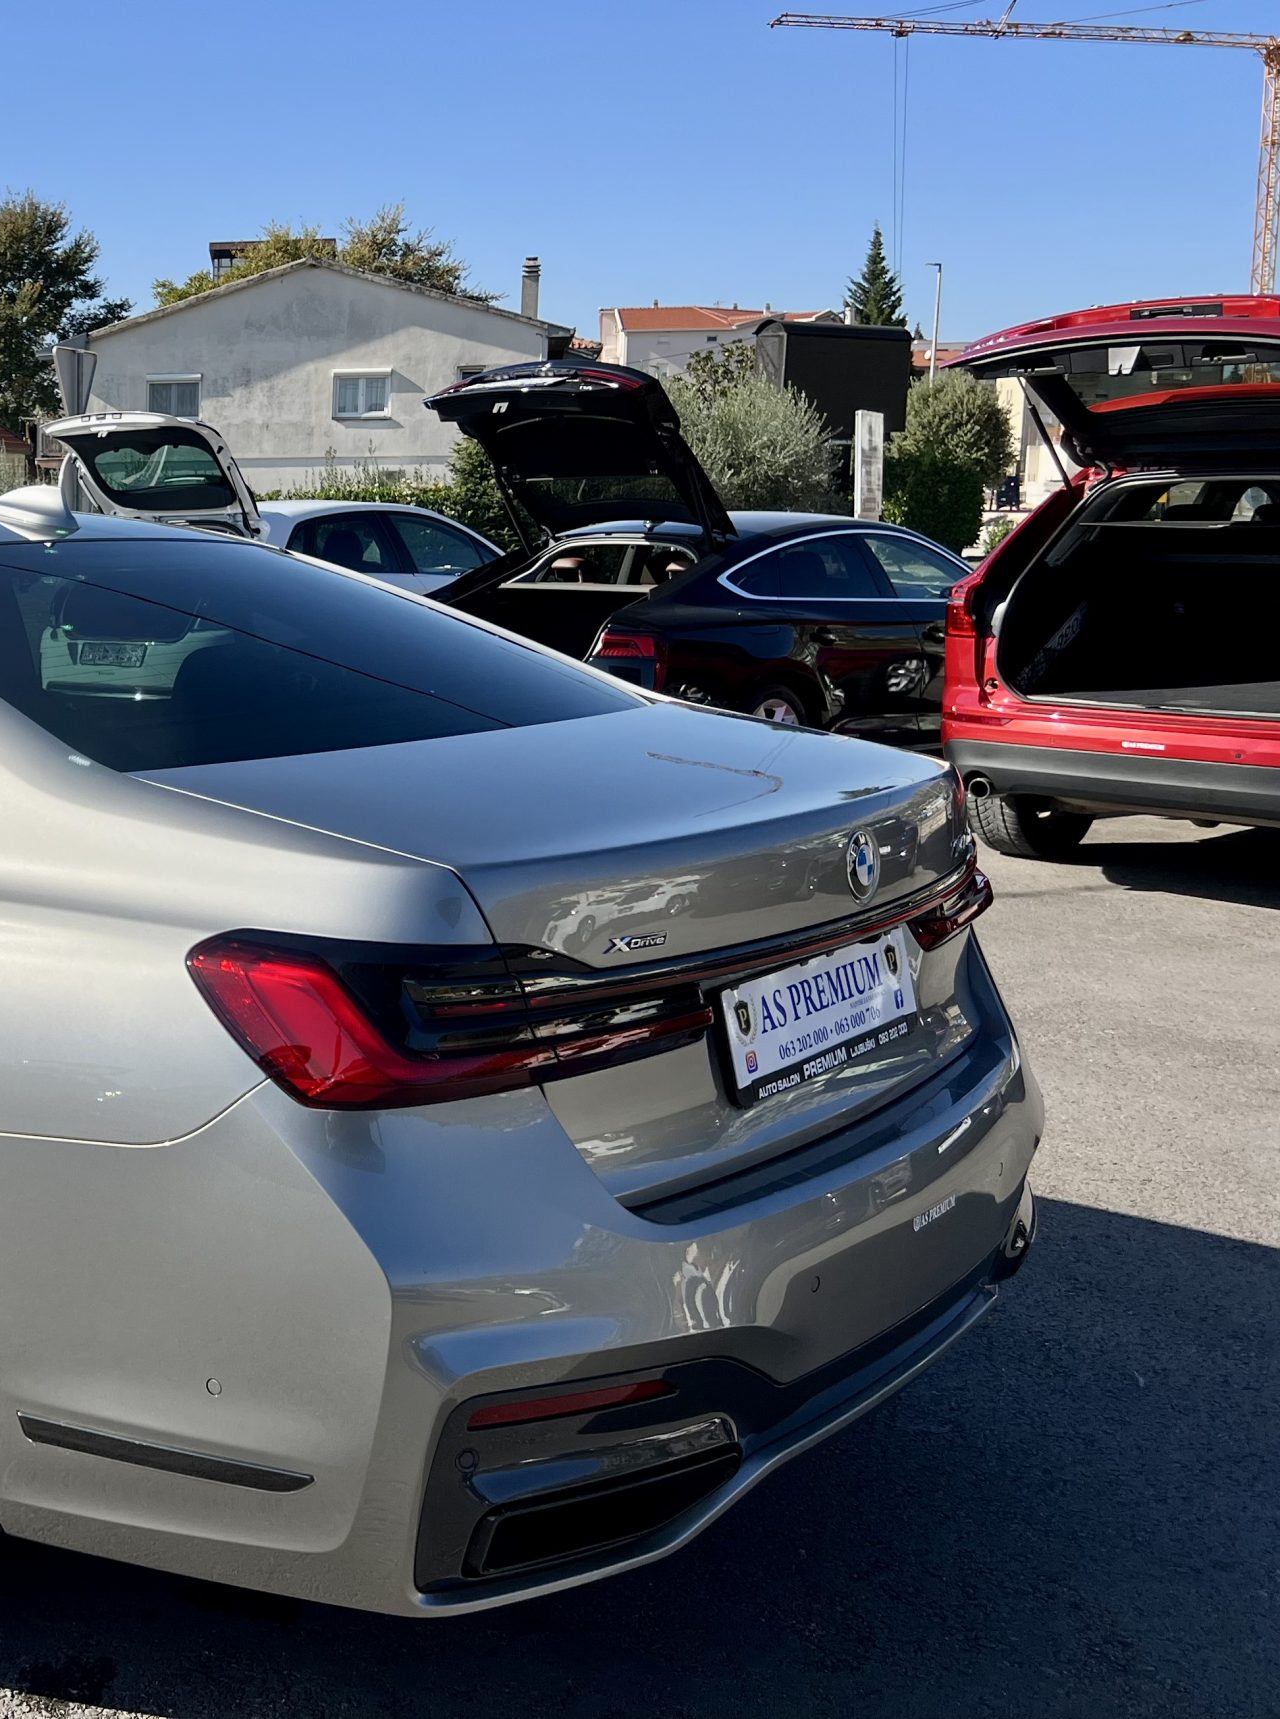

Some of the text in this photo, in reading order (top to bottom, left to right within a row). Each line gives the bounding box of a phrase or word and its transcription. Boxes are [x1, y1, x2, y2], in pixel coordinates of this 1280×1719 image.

[738, 1008, 747, 1029] P
[761, 953, 883, 1034] AS PREMIUM
[779, 1039, 797, 1060] 063
[798, 1033, 814, 1053] 202
[812, 1026, 829, 1046] 000
[834, 1017, 850, 1036] 063
[850, 1009, 866, 1029] 000
[758, 1082, 778, 1100] AUTO
[777, 1072, 801, 1092] SALON
[803, 1047, 848, 1079] PREMIUM
[878, 1031, 889, 1045] 063
[929, 1195, 957, 1223] PREMIUM
